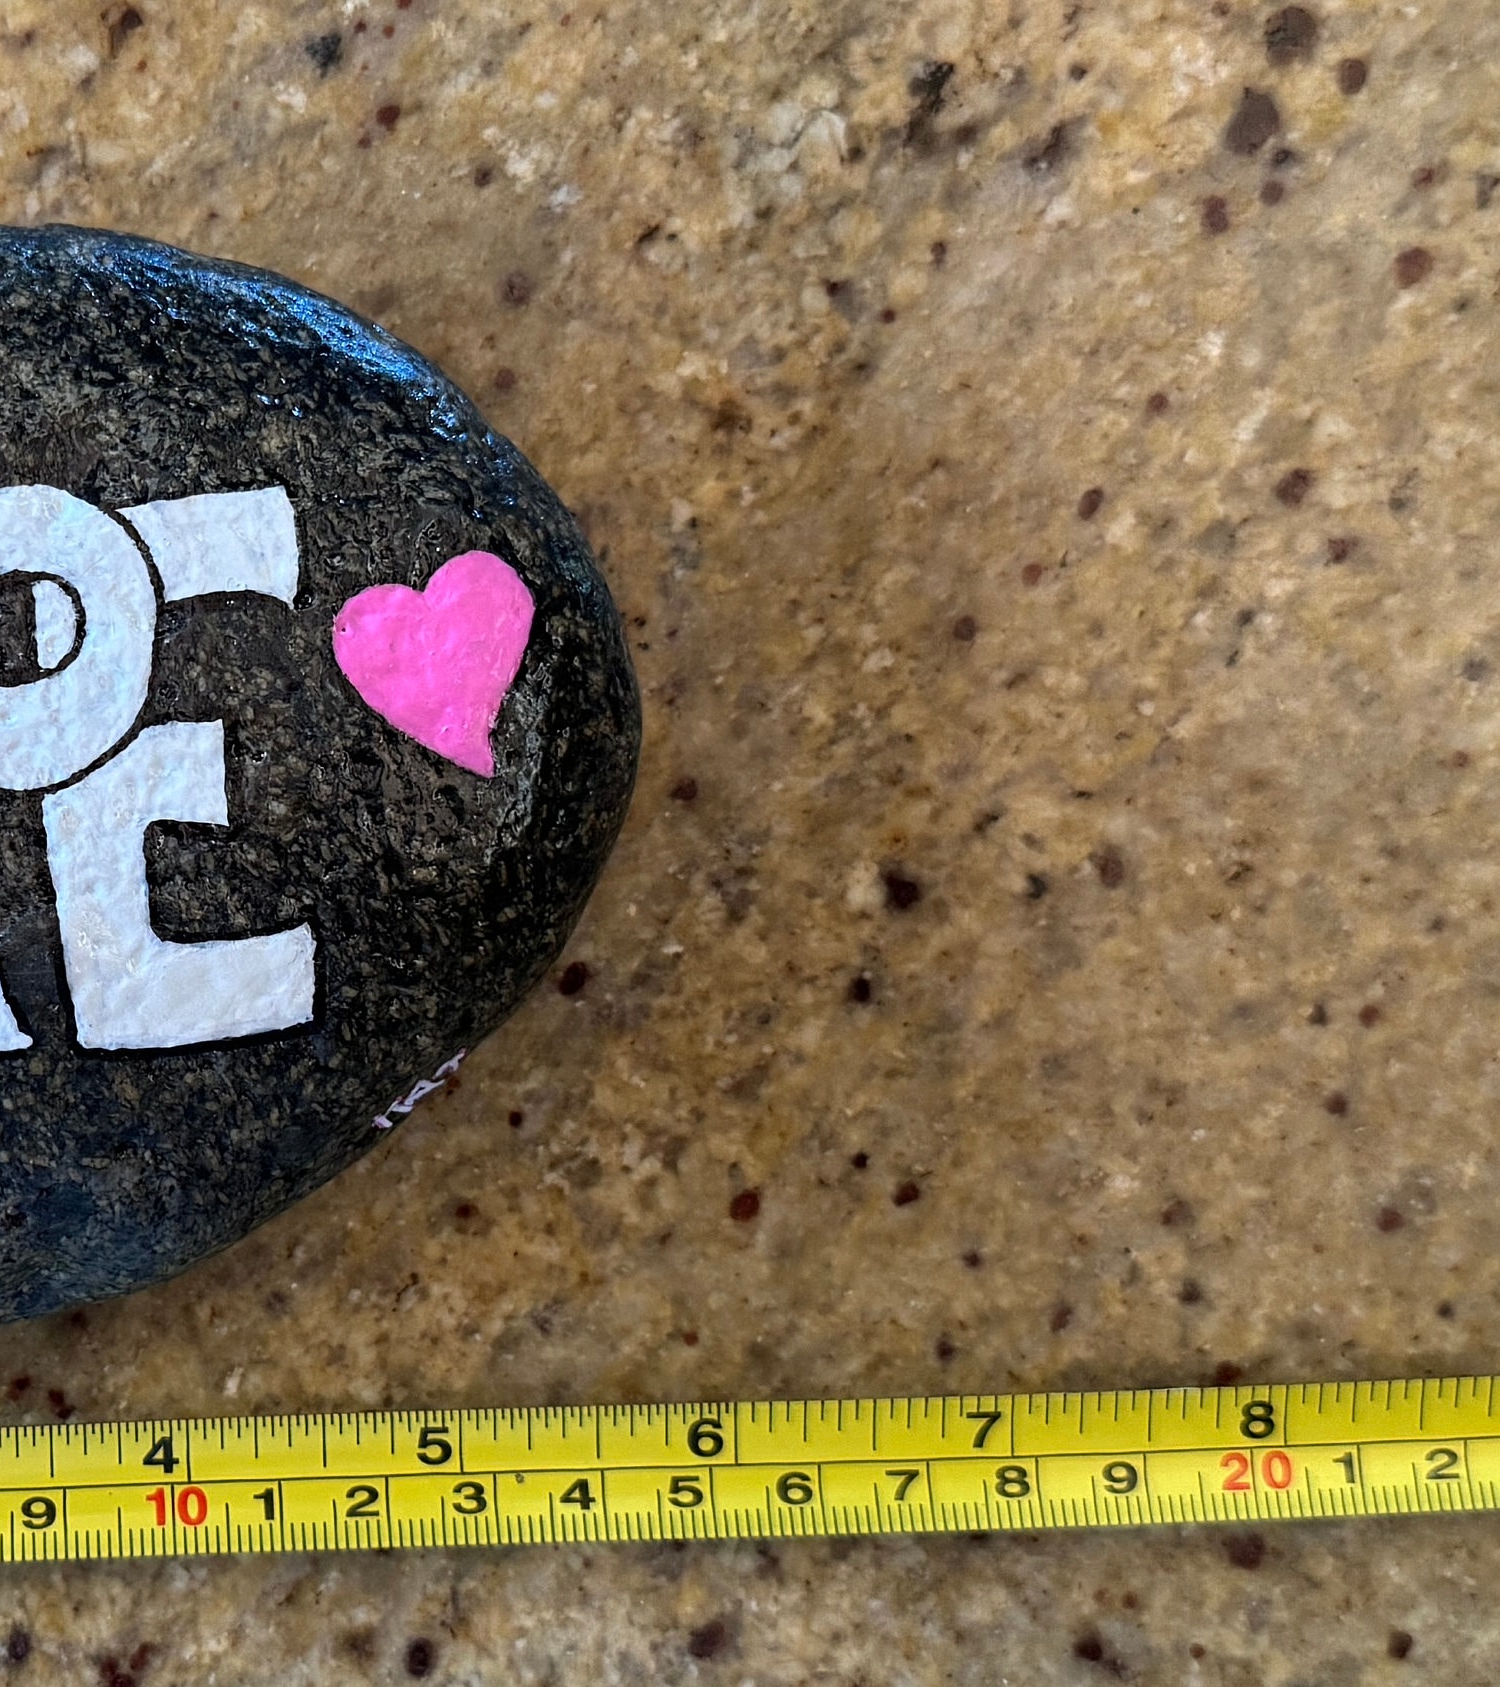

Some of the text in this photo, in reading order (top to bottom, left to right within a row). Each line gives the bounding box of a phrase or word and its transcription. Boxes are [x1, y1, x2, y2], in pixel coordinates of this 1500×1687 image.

[142, 1436, 180, 1474] 4
[416, 1426, 453, 1465] 5
[686, 1417, 724, 1457] 6
[965, 1411, 1002, 1449] 7
[1239, 1400, 1275, 1439] 8
[20, 1496, 58, 1530] 9
[145, 1486, 208, 1526] 10
[253, 1487, 276, 1521] 1
[345, 1484, 381, 1519] 2
[451, 1480, 488, 1515] 3
[559, 1478, 596, 1511] 4
[668, 1475, 704, 1508] 5
[775, 1471, 814, 1506] 6
[885, 1469, 920, 1501] 7
[995, 1464, 1031, 1499] 8
[1102, 1461, 1139, 1495] 9
[1220, 1449, 1293, 1491] 20
[1332, 1451, 1356, 1485] 1
[1424, 1447, 1460, 1480] 2
